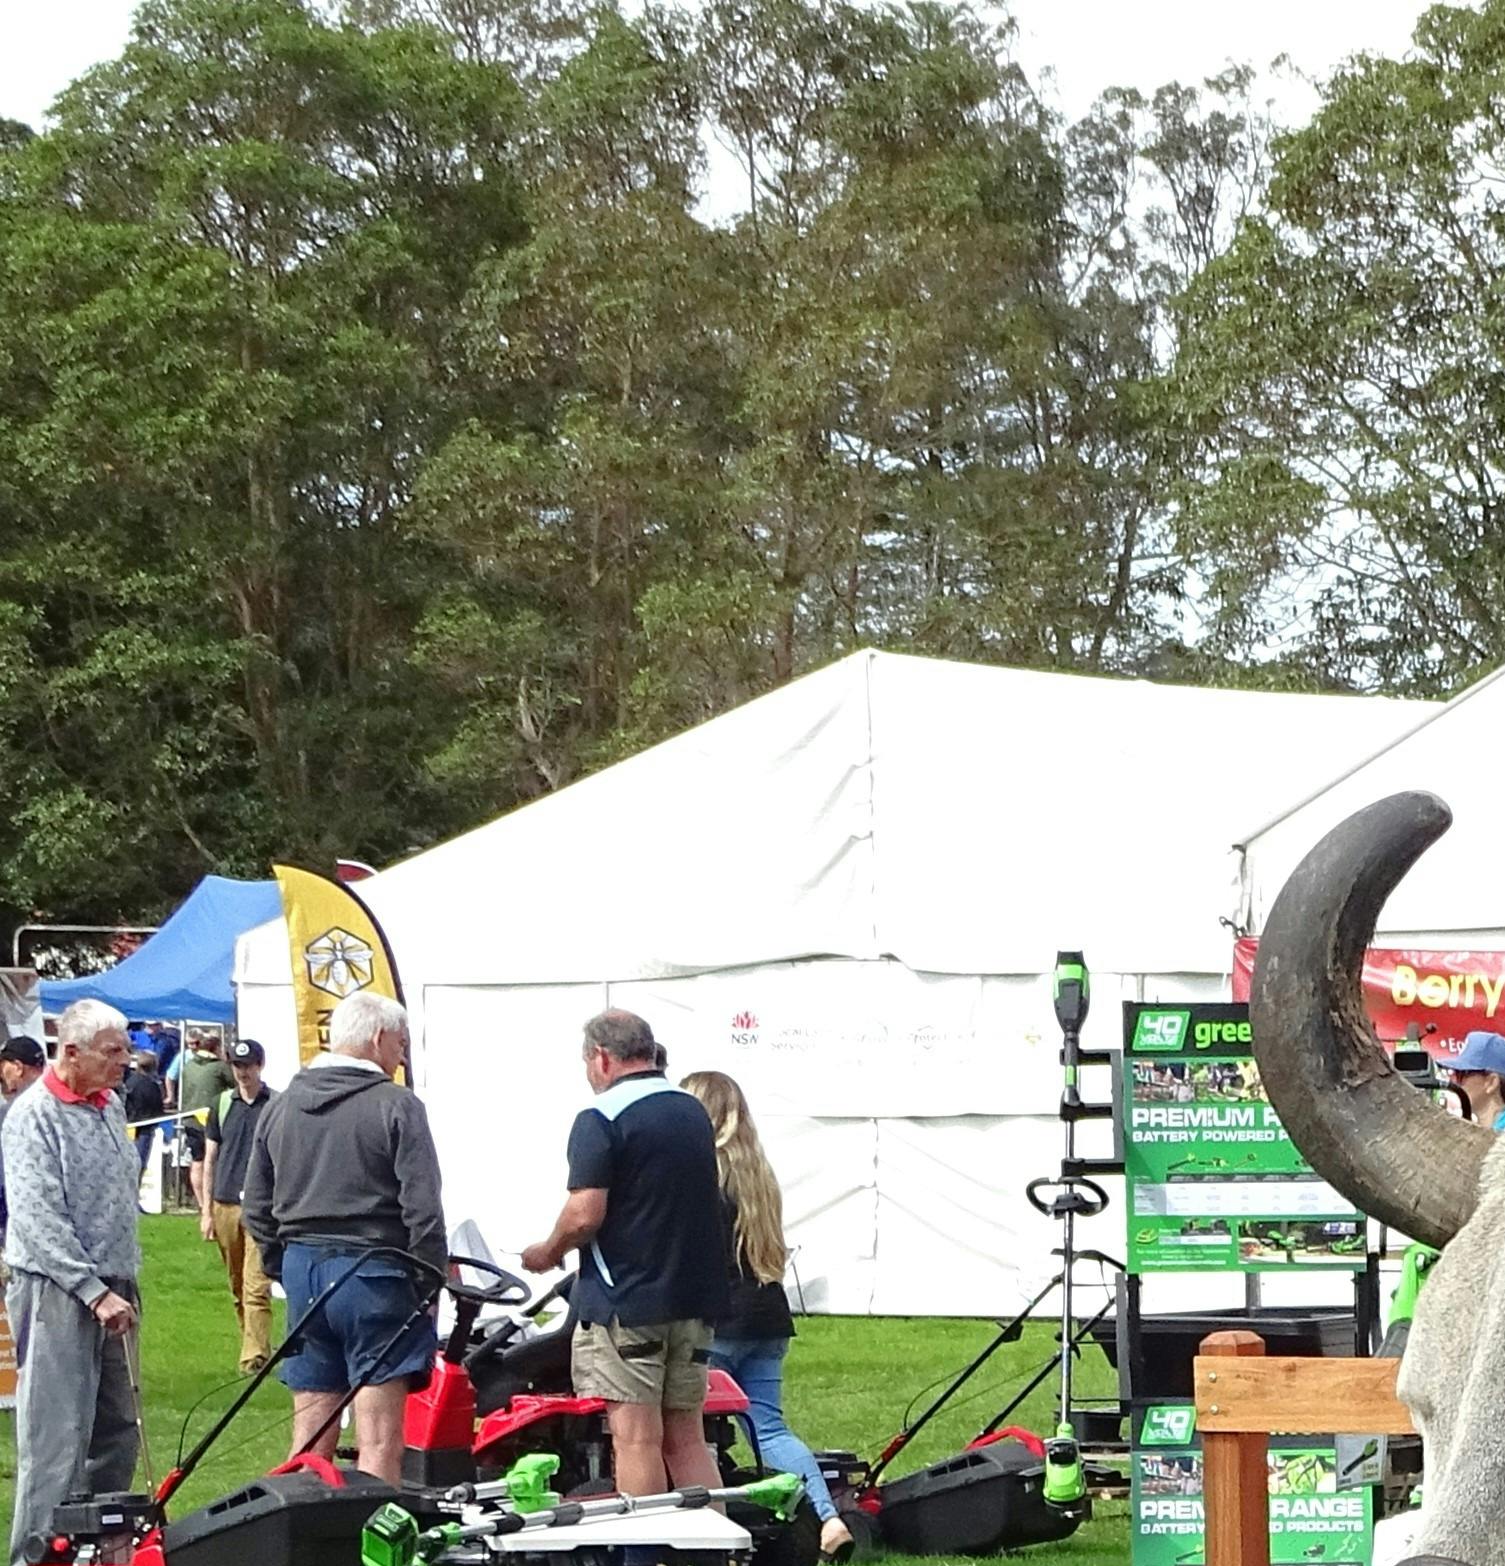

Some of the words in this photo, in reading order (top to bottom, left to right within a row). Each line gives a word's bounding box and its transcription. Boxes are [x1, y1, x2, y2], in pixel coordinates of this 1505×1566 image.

[1142, 1014, 1184, 1035] 40
[1194, 1021, 1253, 1049] gree
[1132, 1108, 1255, 1128] PREMIUM
[1132, 1131, 1197, 1143] BATTERY
[1202, 1131, 1276, 1143] POWERED
[1151, 1410, 1191, 1429] 40
[1270, 1498, 1365, 1518] RANGE
[1286, 1521, 1365, 1533] PRODUCTS
